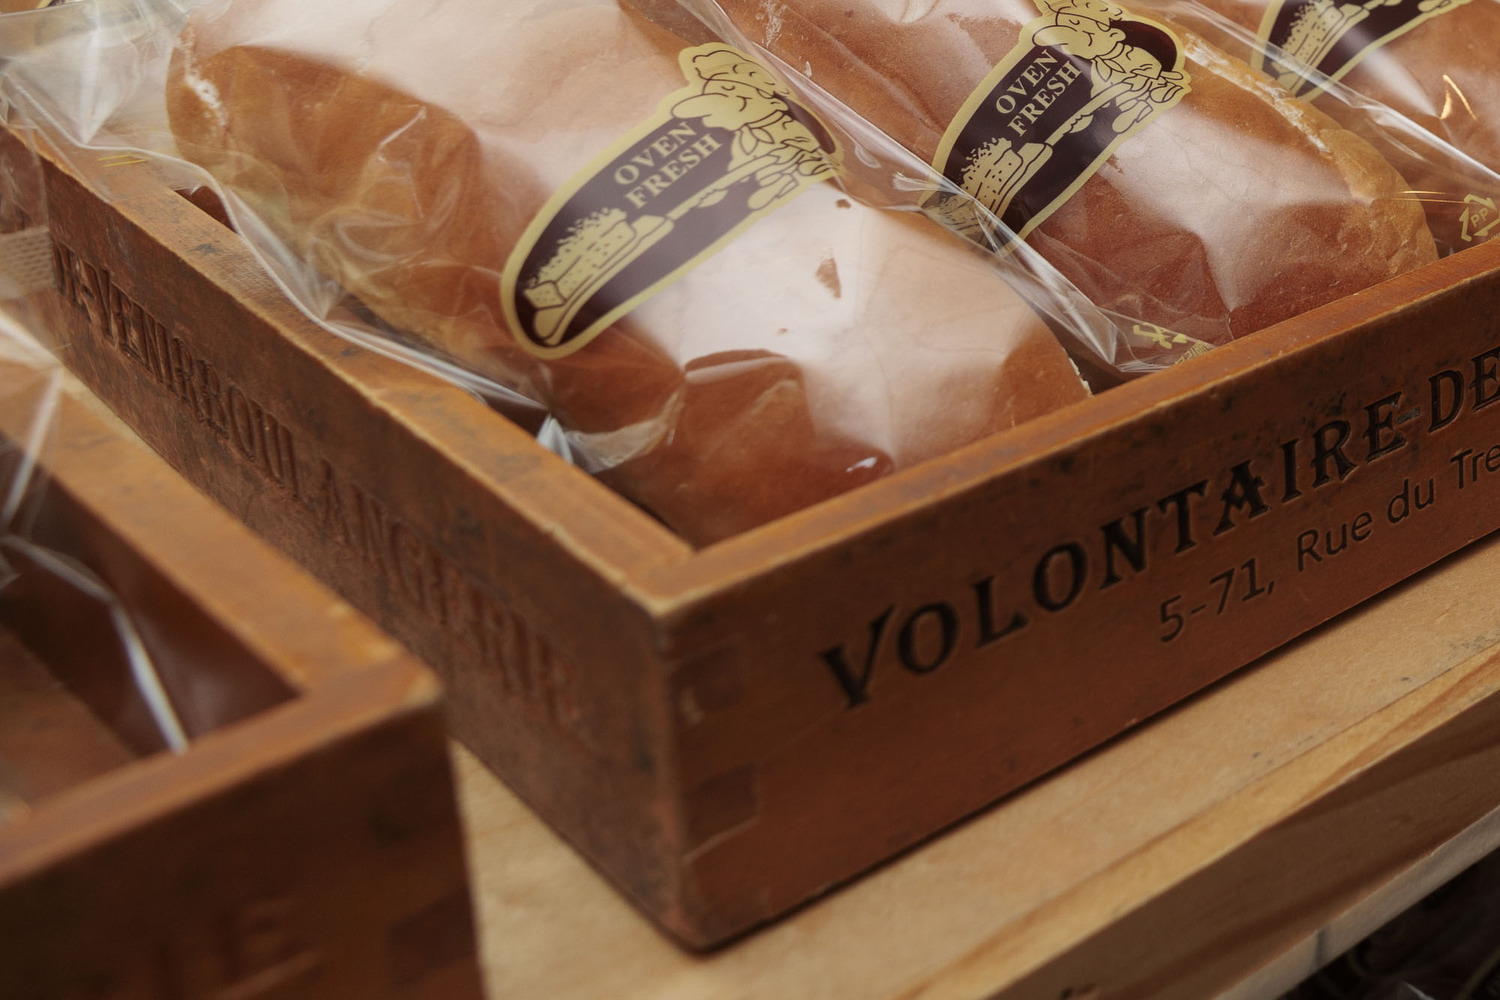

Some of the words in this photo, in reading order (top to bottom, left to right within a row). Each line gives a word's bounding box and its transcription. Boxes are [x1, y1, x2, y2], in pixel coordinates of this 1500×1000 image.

[996, 49, 1058, 114] OVEN
[1007, 60, 1082, 137] FRESH
[615, 121, 697, 185] OVEN
[624, 133, 723, 209] FRESH
[1470, 207, 1489, 228] PP
[1159, 557, 1275, 643] 5-71,
[1297, 511, 1374, 572] Rue
[1387, 478, 1435, 525] du
